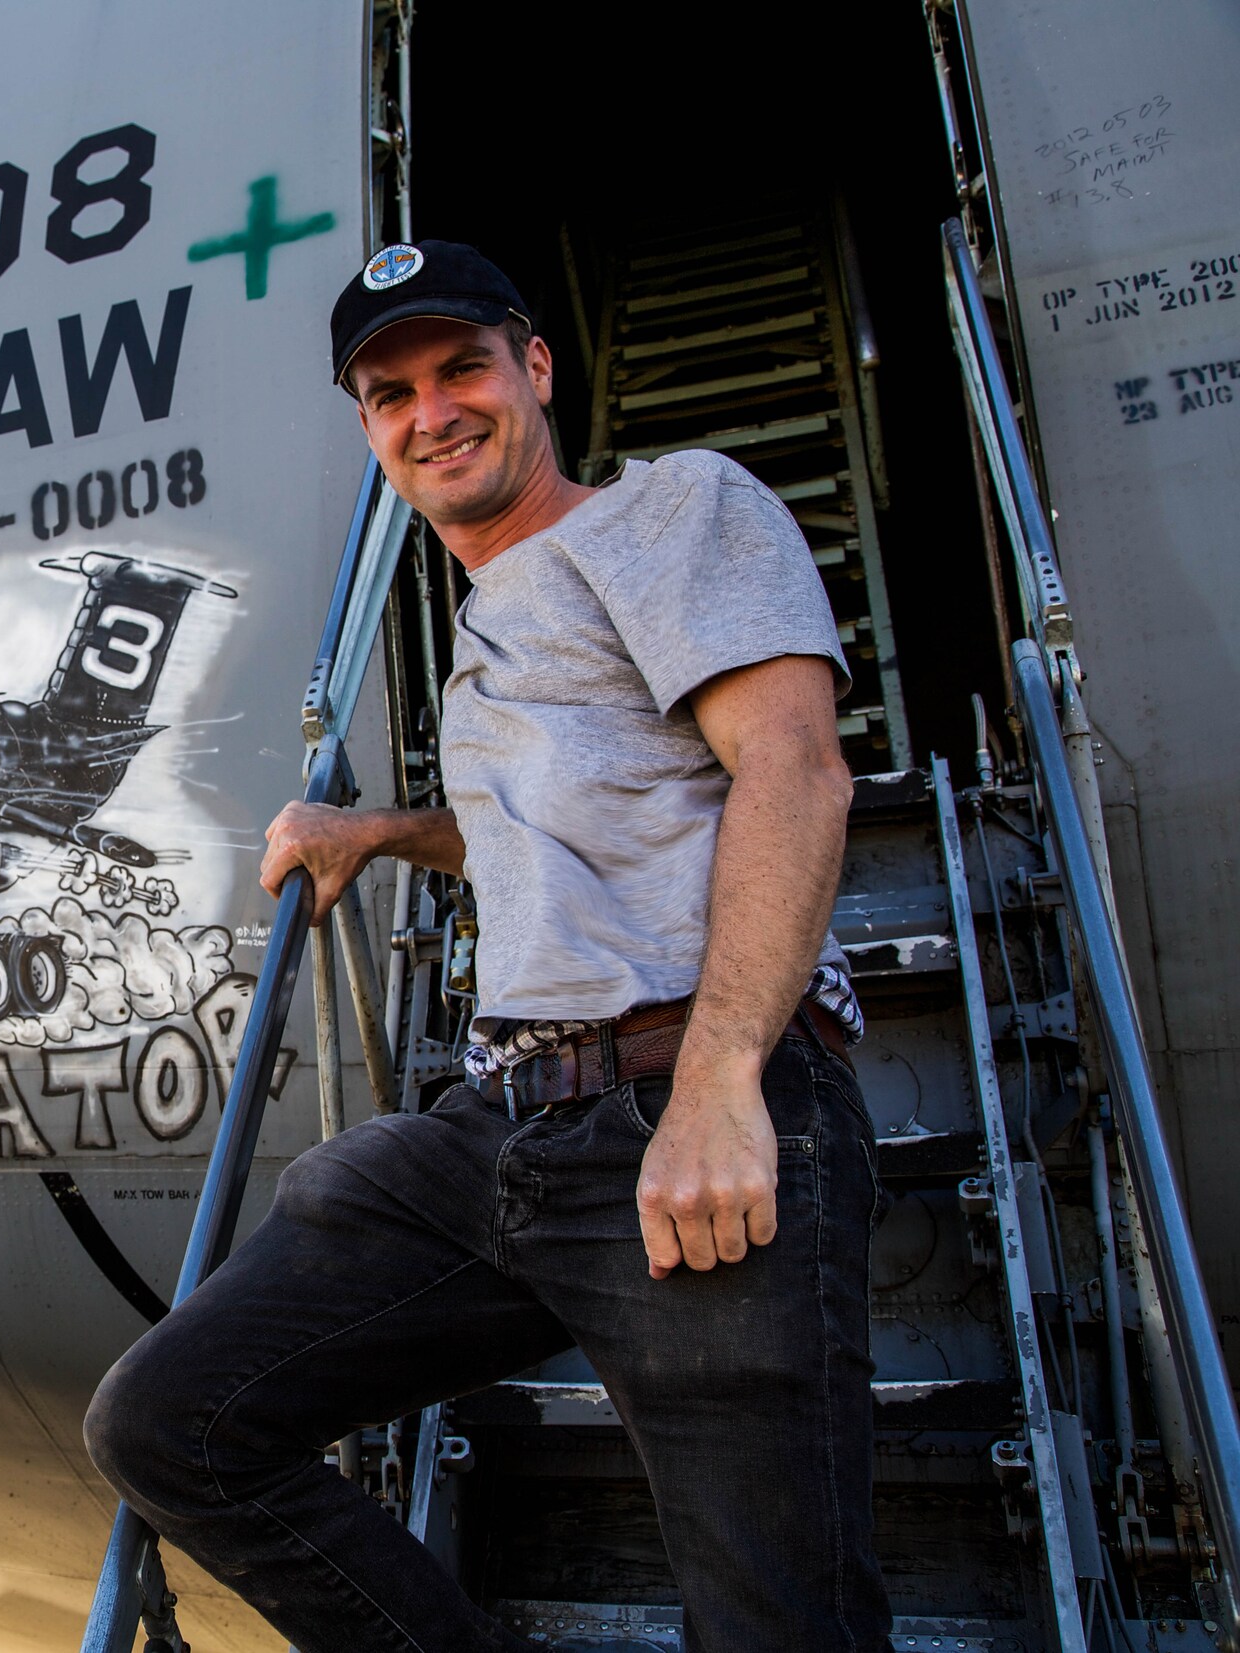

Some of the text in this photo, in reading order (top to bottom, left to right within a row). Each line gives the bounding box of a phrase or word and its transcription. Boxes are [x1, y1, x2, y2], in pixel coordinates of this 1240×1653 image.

[1103, 108, 1134, 132] 05
[1139, 95, 1171, 119] 03
[1059, 128, 1176, 174] SAFE FOR
[1094, 140, 1170, 182] MAINT
[1043, 288, 1076, 311] OP
[1096, 269, 1170, 298] TYPE
[1052, 280, 1236, 332] 1 JUN 2012
[1168, 360, 1240, 390] TYPE
[1121, 385, 1233, 425] 23 AUG
[81, 604, 164, 690] 3
[114, 1190, 137, 1199] MAX
[141, 1190, 164, 1199] TOW
[168, 1190, 190, 1199] BAR
